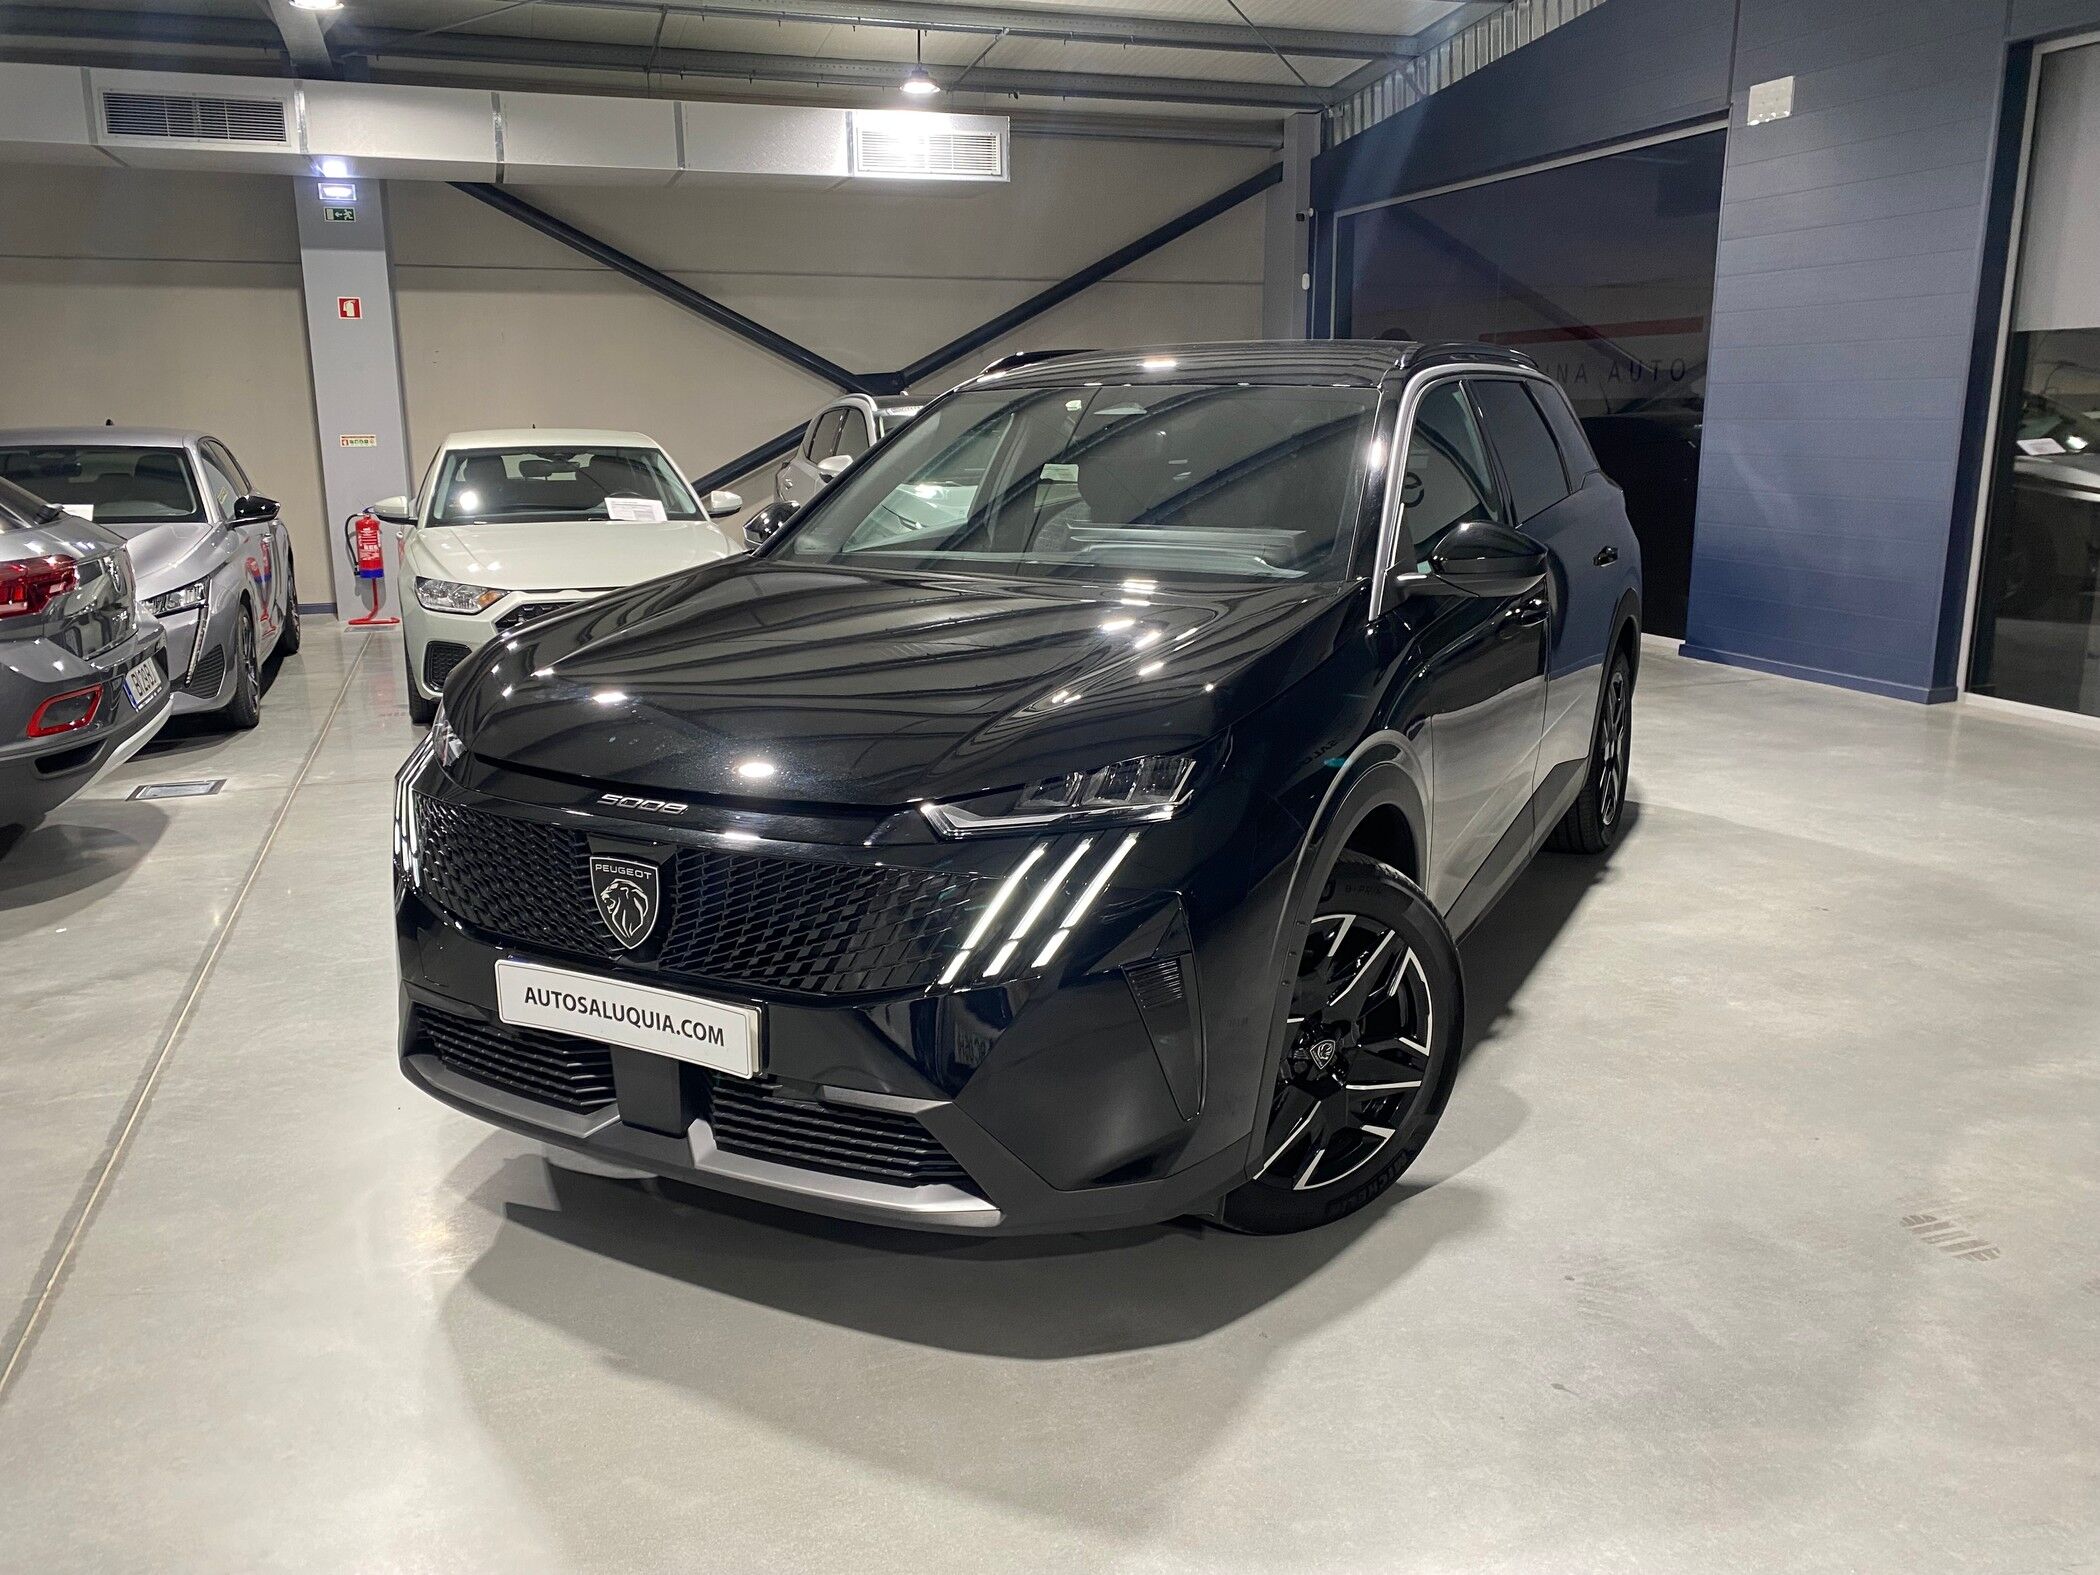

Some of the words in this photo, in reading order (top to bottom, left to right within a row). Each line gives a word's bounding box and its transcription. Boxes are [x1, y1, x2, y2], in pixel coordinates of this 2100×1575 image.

[1607, 358, 1686, 383] AUTO
[597, 793, 689, 815] 5008
[595, 863, 652, 880] PEUGEOT
[524, 986, 725, 1047] AUTOSALUQUIA.COM
